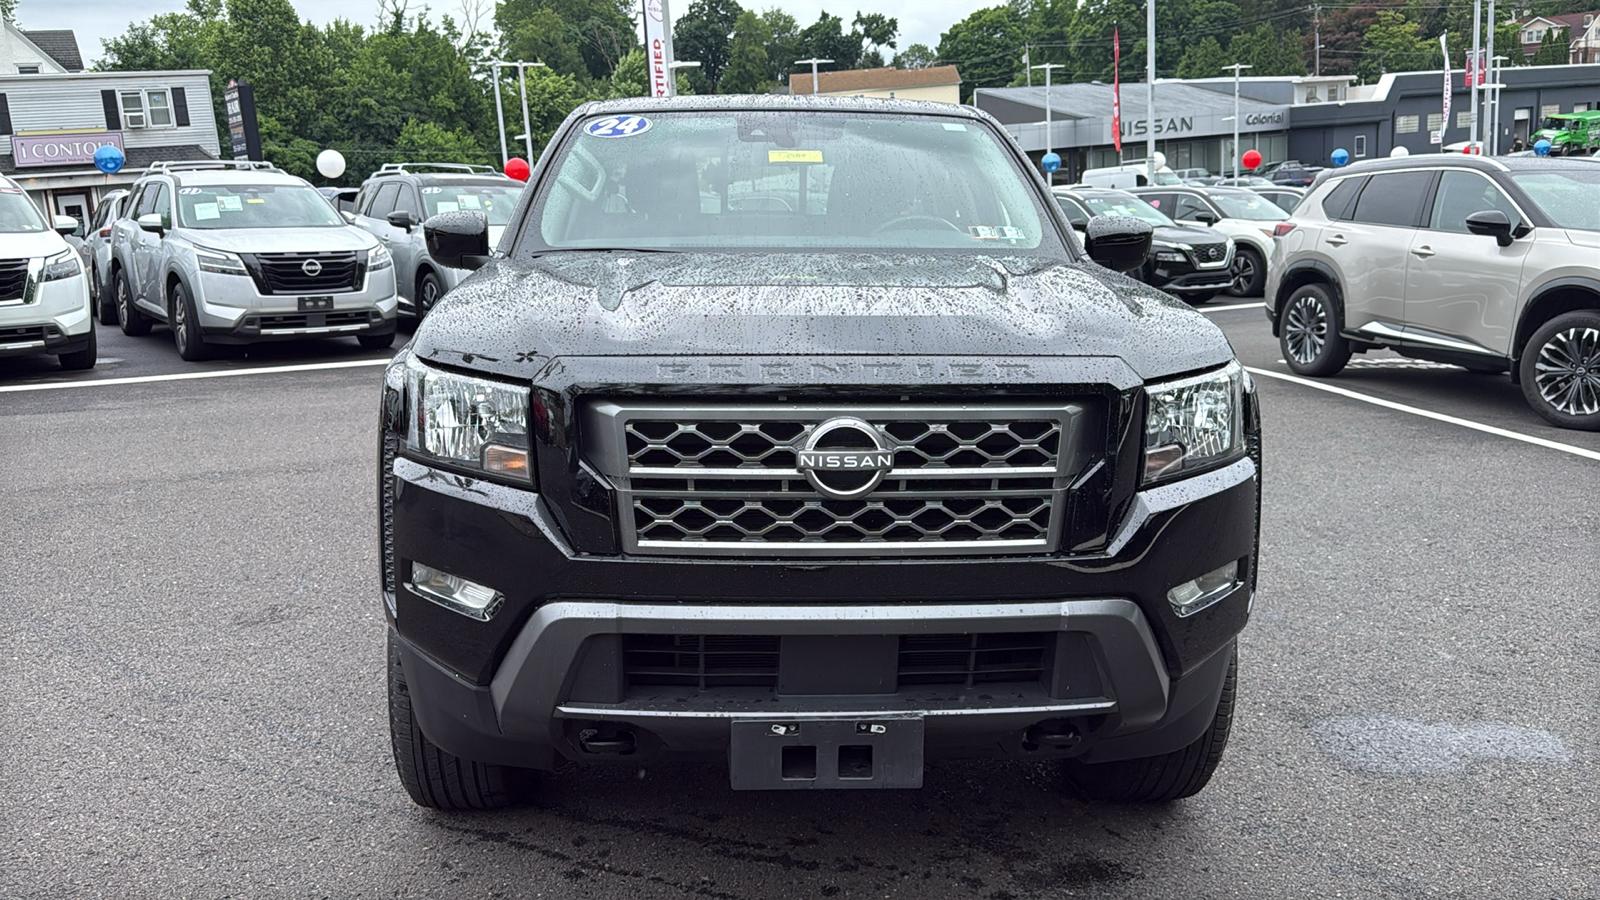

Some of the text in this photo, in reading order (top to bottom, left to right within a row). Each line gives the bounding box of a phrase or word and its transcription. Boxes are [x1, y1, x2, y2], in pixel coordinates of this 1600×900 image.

[653, 38, 665, 98] RTIFIED
[592, 117, 640, 135] 24
[1246, 112, 1284, 125] Colonial
[20, 142, 27, 159] i
[656, 363, 1036, 379] FRONTIER
[800, 455, 891, 467] NISSAN
